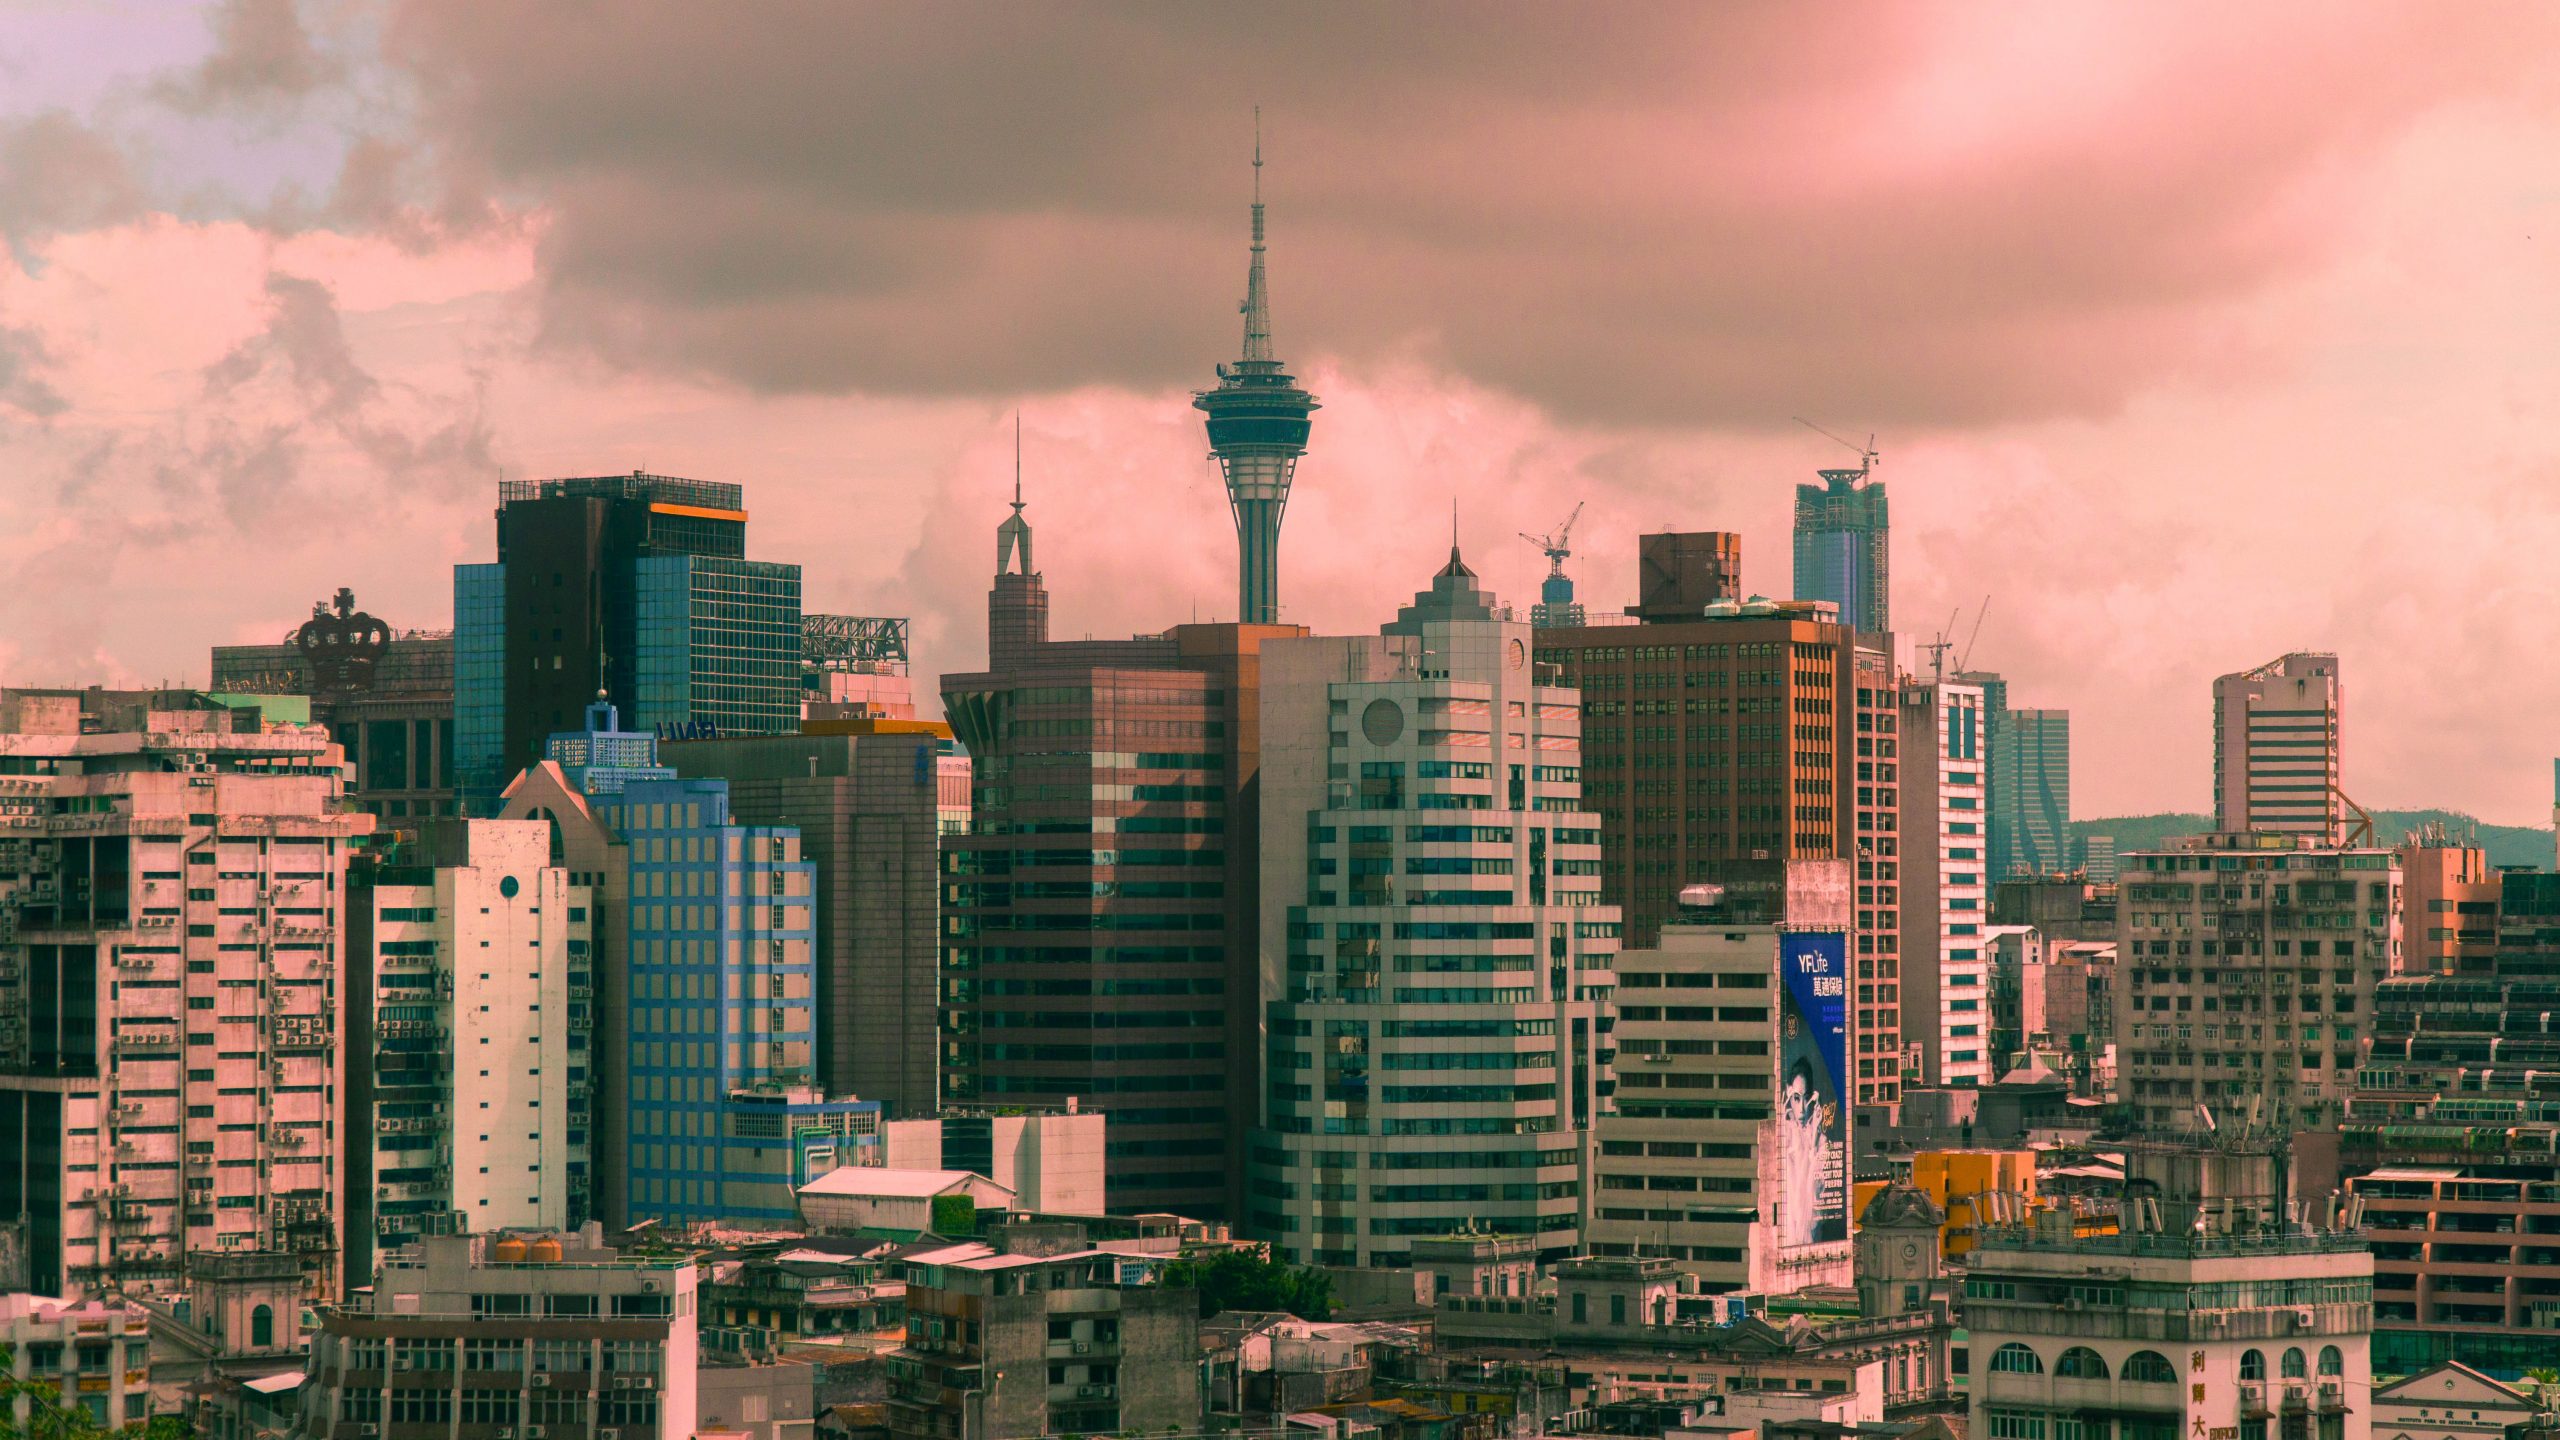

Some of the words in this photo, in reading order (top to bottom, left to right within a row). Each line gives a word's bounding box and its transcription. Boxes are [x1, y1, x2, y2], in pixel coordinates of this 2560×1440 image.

[1798, 950, 1828, 973] YFLife
[1813, 976, 1843, 997] 萬通保險
